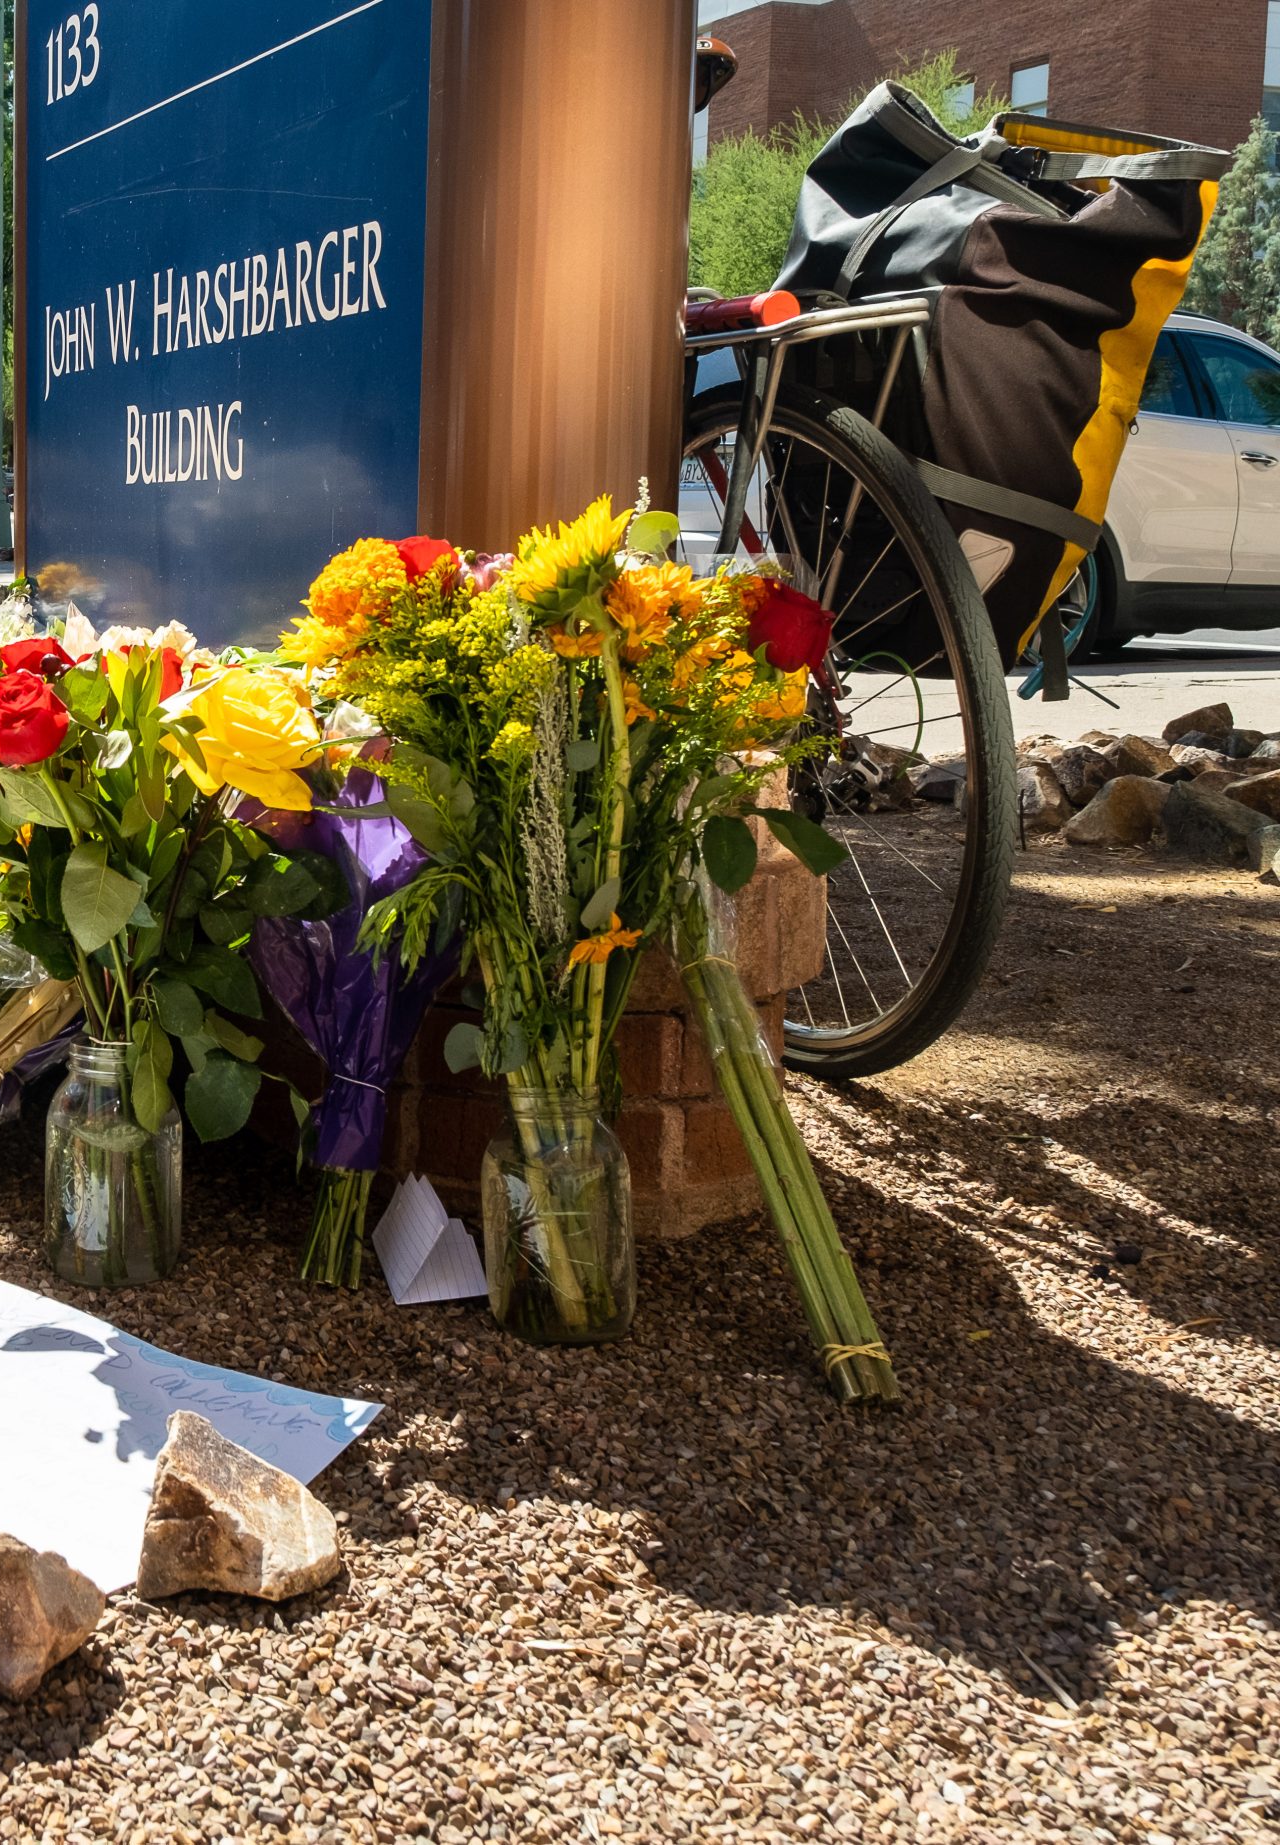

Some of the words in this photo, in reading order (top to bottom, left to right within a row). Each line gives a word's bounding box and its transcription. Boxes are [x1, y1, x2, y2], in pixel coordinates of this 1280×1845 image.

[47, 3, 99, 105] 1133
[45, 303, 94, 401] JOHN
[106, 280, 138, 364] W.
[153, 221, 386, 355] HARSHBARGER
[126, 401, 243, 484] BUILDING
